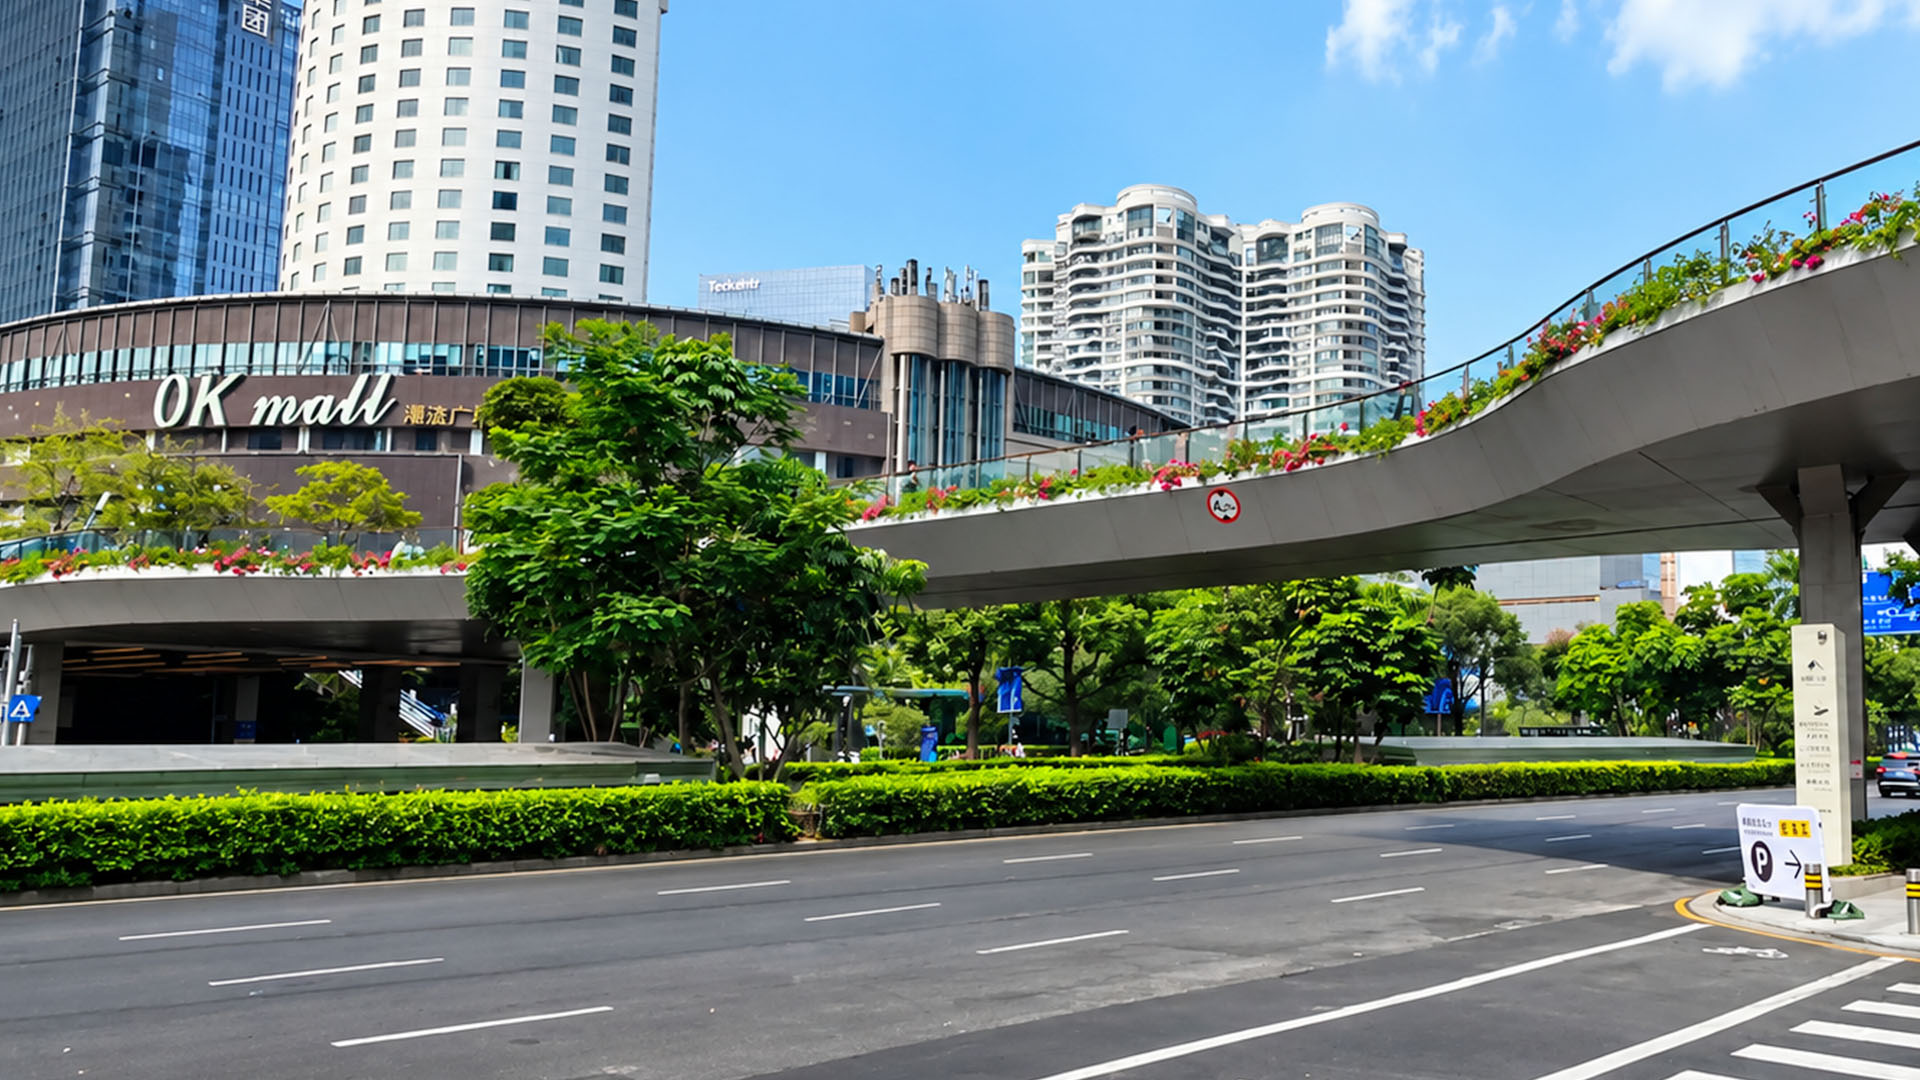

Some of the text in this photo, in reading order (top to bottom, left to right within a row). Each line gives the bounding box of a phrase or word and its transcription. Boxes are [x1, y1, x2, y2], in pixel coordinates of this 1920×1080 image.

[153, 373, 396, 428] OK mall
[1754, 846, 1769, 875] P
